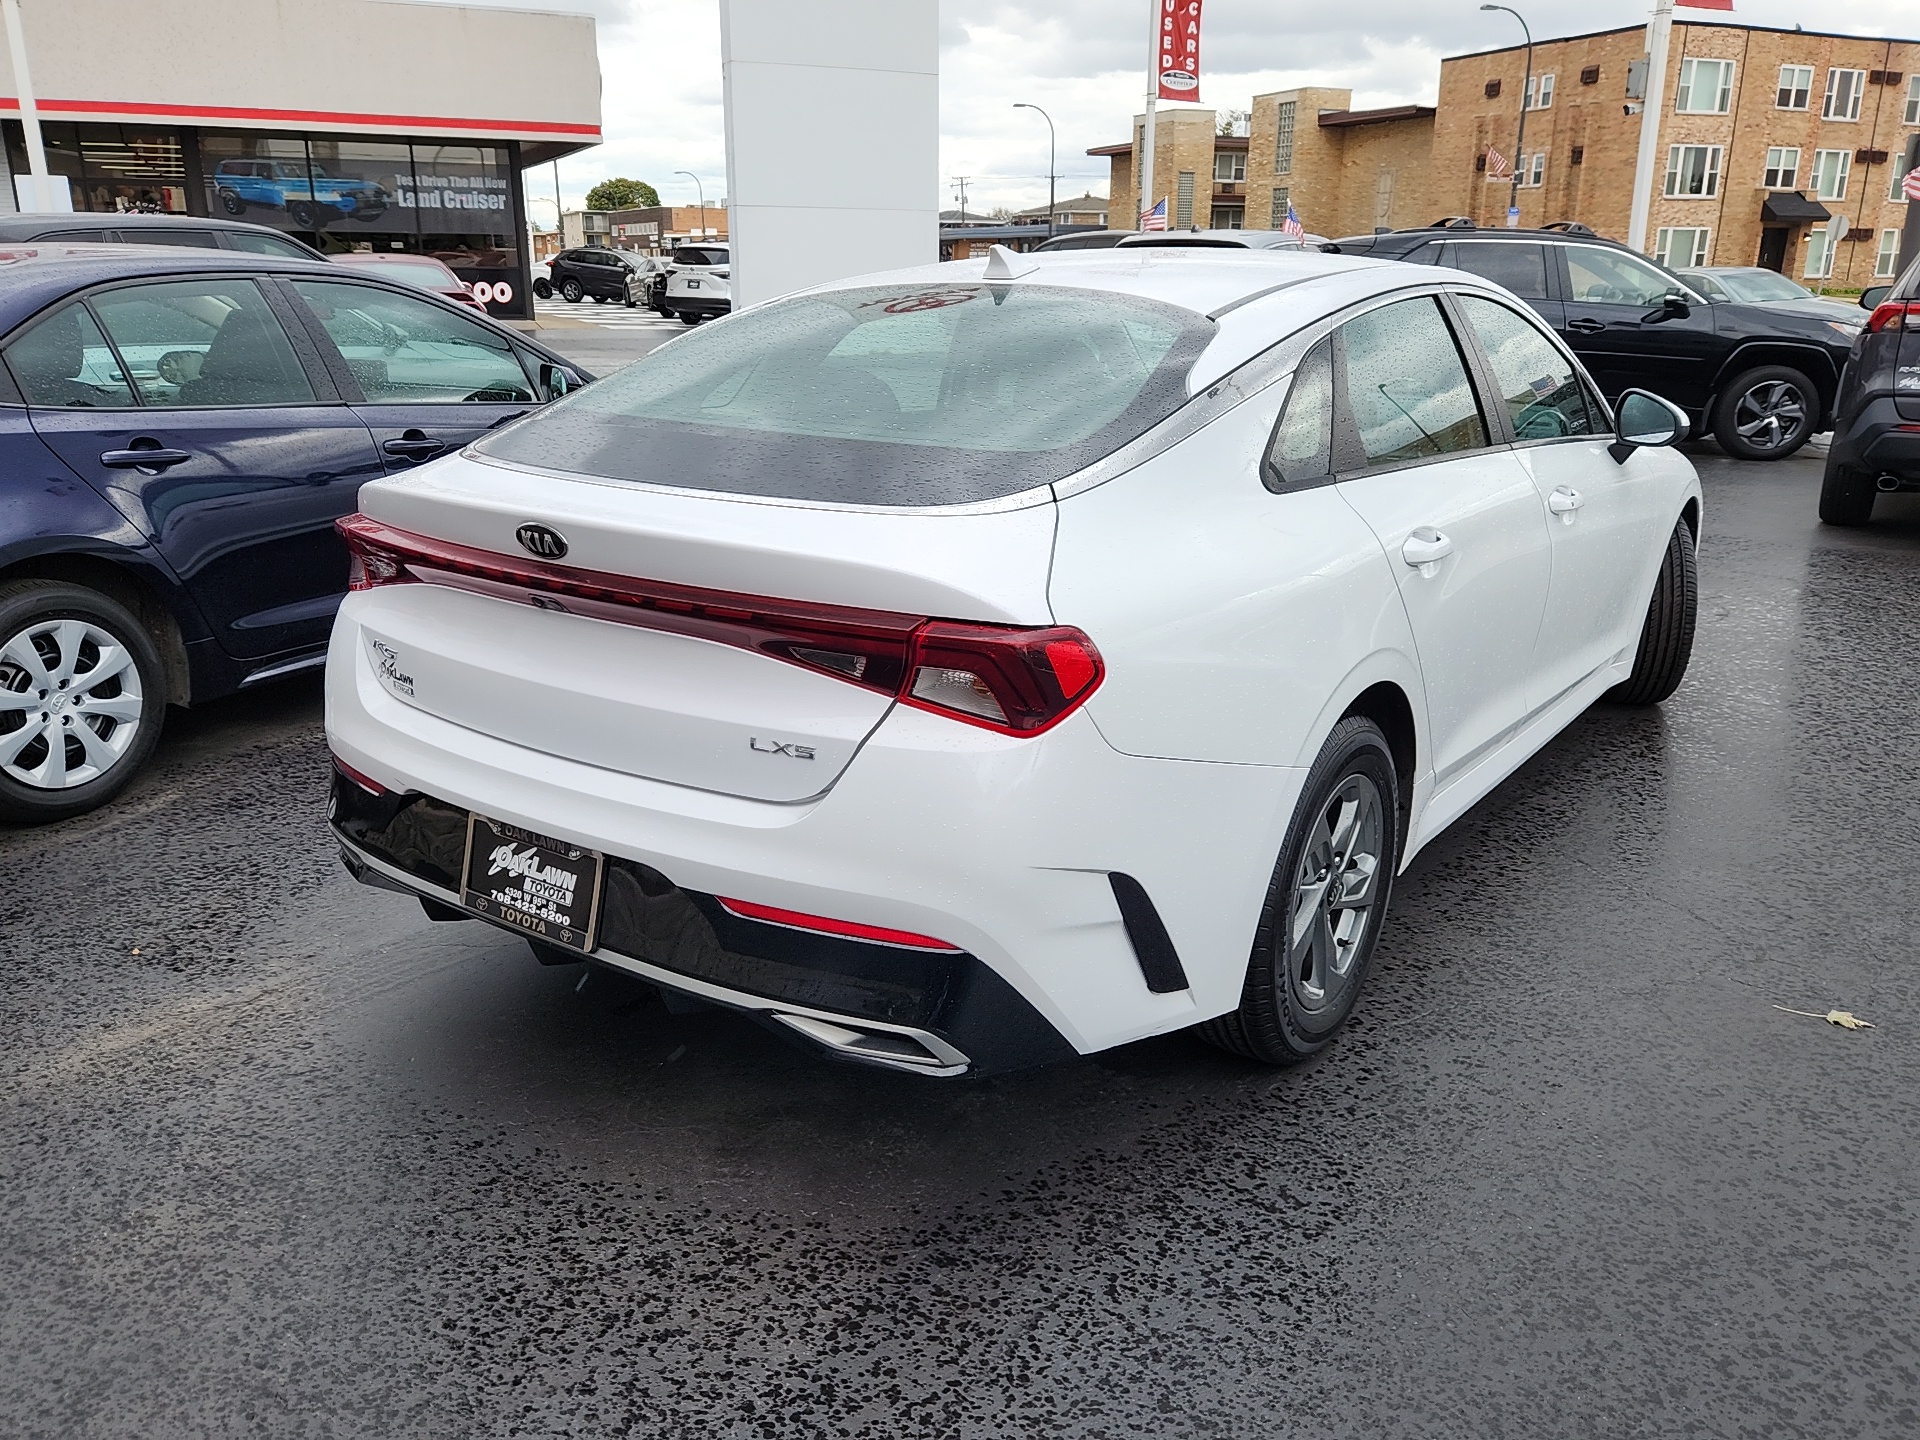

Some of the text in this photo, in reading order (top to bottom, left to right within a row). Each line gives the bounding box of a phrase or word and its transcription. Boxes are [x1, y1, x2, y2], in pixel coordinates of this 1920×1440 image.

[1162, 0, 1175, 68] USED
[1185, 2, 1199, 71] CARS
[395, 174, 507, 189] Test Drive The All New
[398, 189, 506, 210] Land Cruiser
[461, 281, 513, 303] 00
[519, 528, 561, 555] KIA
[749, 736, 817, 760] LXS
[504, 824, 565, 854] OAK LAWN
[504, 886, 522, 899] 4320
[523, 893, 532, 903] W
[547, 901, 557, 912] St
[529, 880, 568, 904] TOYOTA
[490, 889, 571, 926] 708-423-5200
[500, 905, 546, 934] TOYOTA
